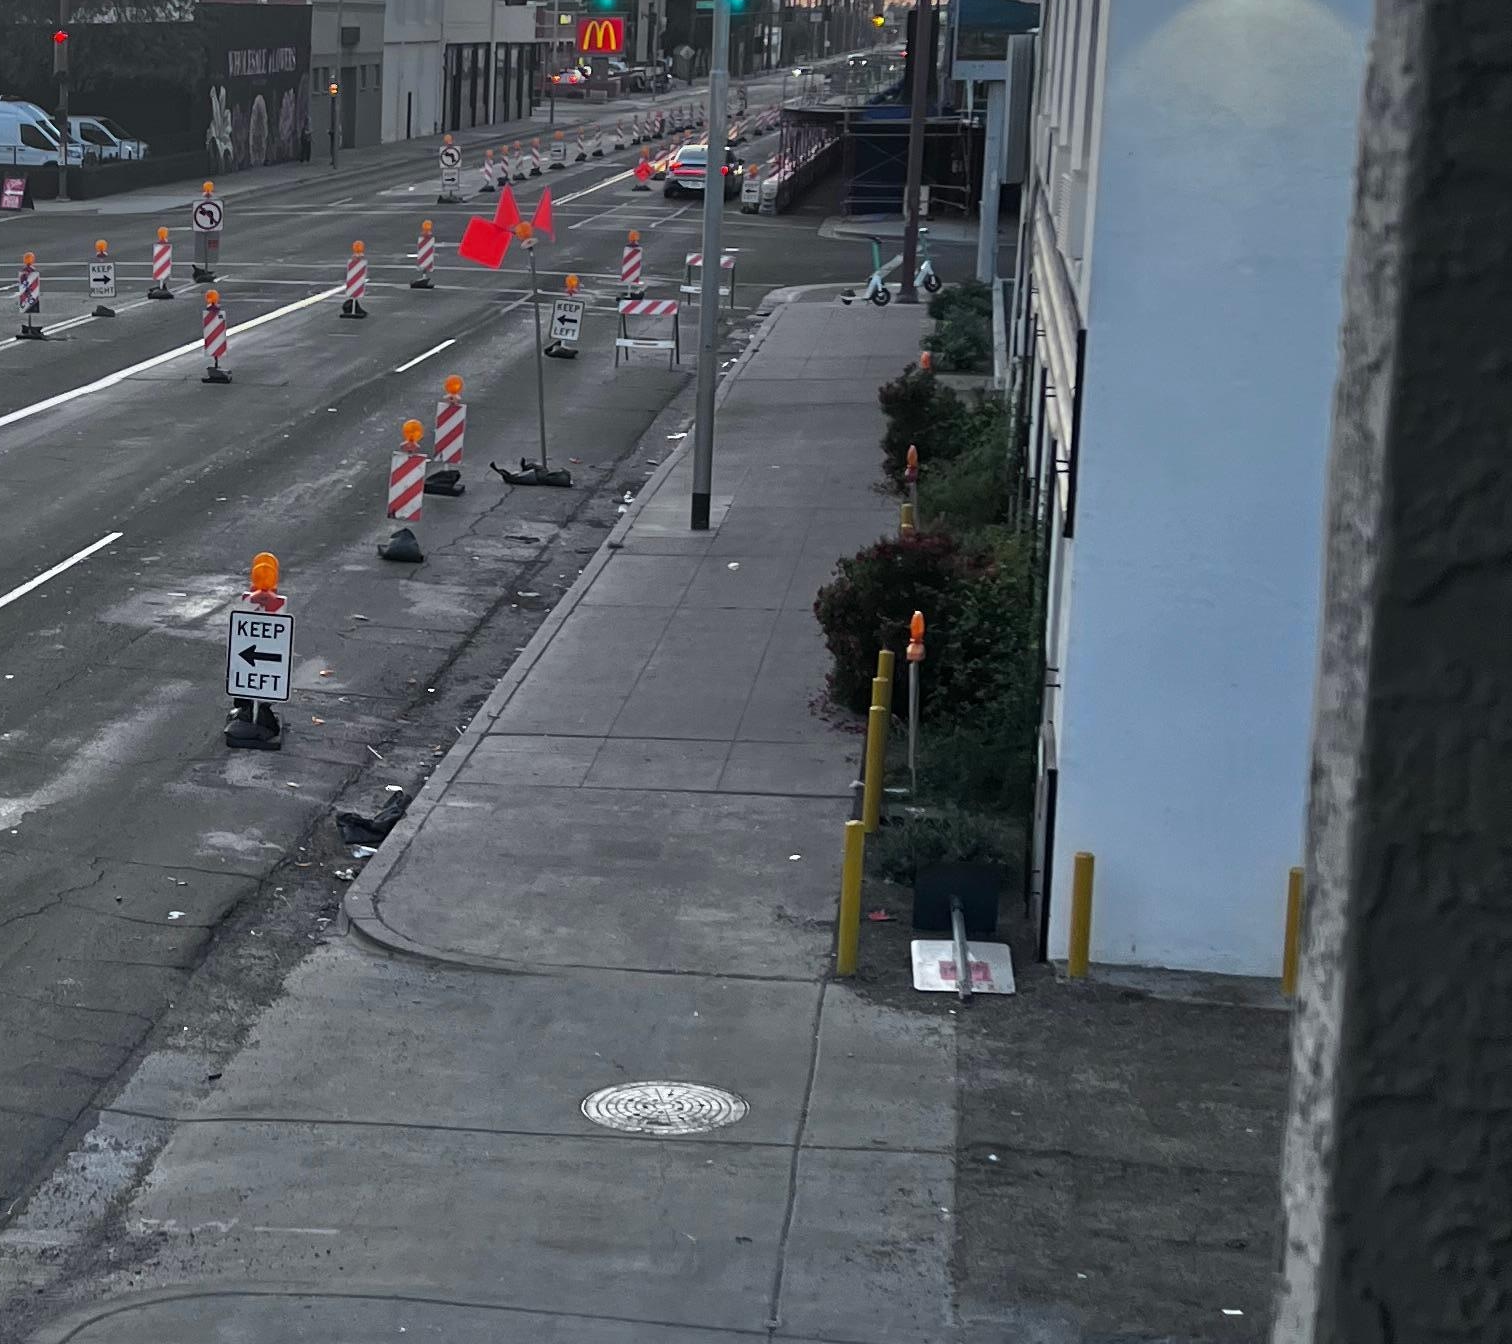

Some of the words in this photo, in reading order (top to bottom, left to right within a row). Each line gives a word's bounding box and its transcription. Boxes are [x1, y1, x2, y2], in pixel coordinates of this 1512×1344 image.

[557, 303, 581, 312] KEEP
[553, 327, 576, 336] LEFT
[237, 620, 285, 639] KEEP
[235, 671, 281, 691] LEFT
